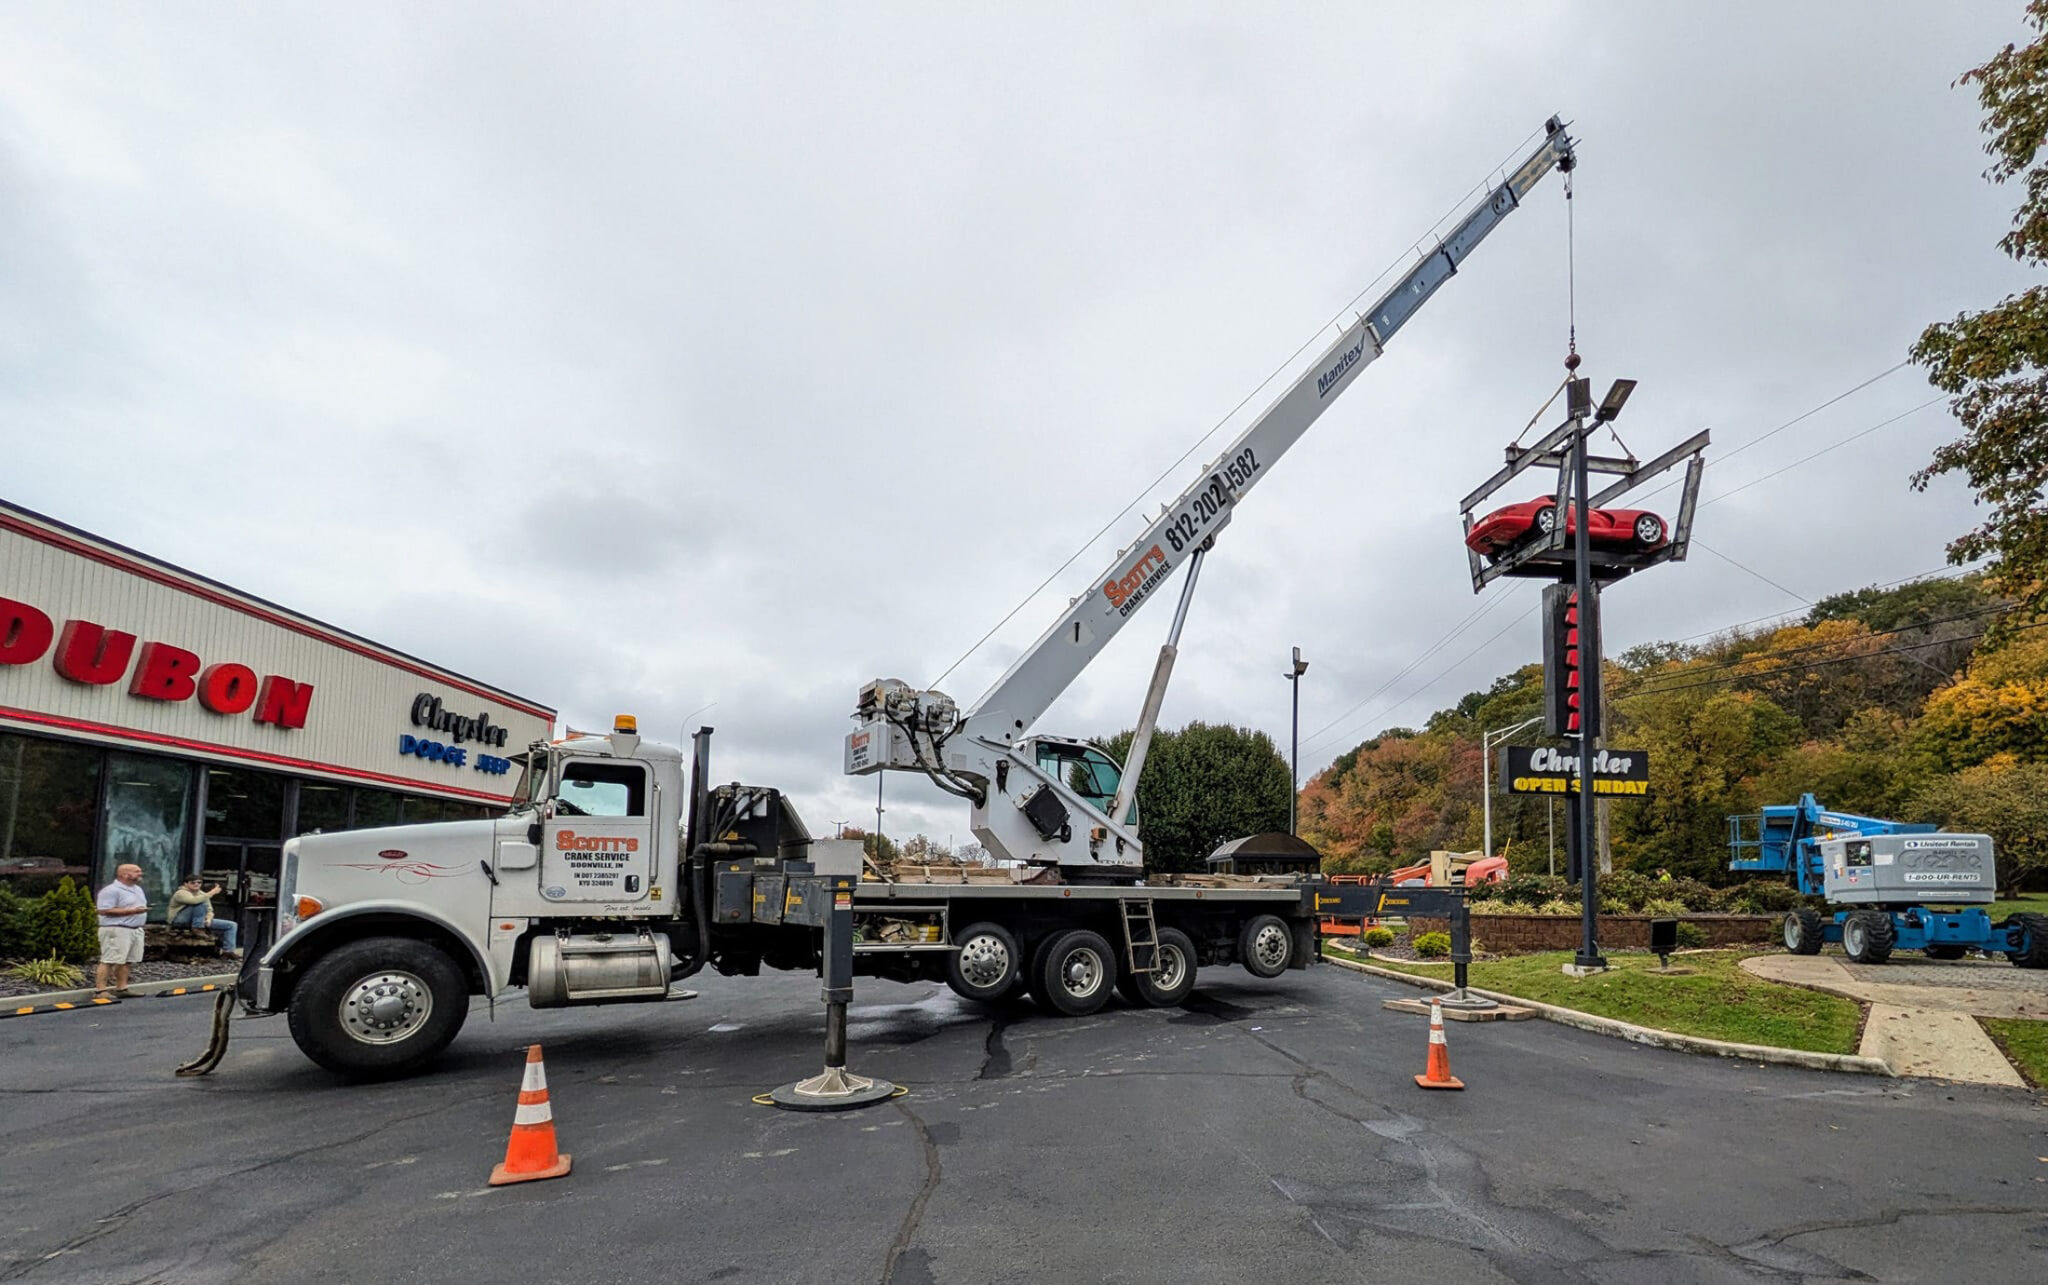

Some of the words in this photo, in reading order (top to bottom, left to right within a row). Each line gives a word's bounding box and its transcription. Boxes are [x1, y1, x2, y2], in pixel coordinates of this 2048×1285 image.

[1317, 341, 1363, 394] Manitex
[1119, 589, 1145, 618] CRANE
[1141, 560, 1172, 593] SERVICE
[411, 692, 508, 747] Chrysler
[399, 734, 467, 768] DODGE
[473, 753, 511, 775] JEEP
[1513, 777, 1567, 792] OPEN
[564, 852, 593, 861] CRANE
[595, 852, 631, 861] SERVICE
